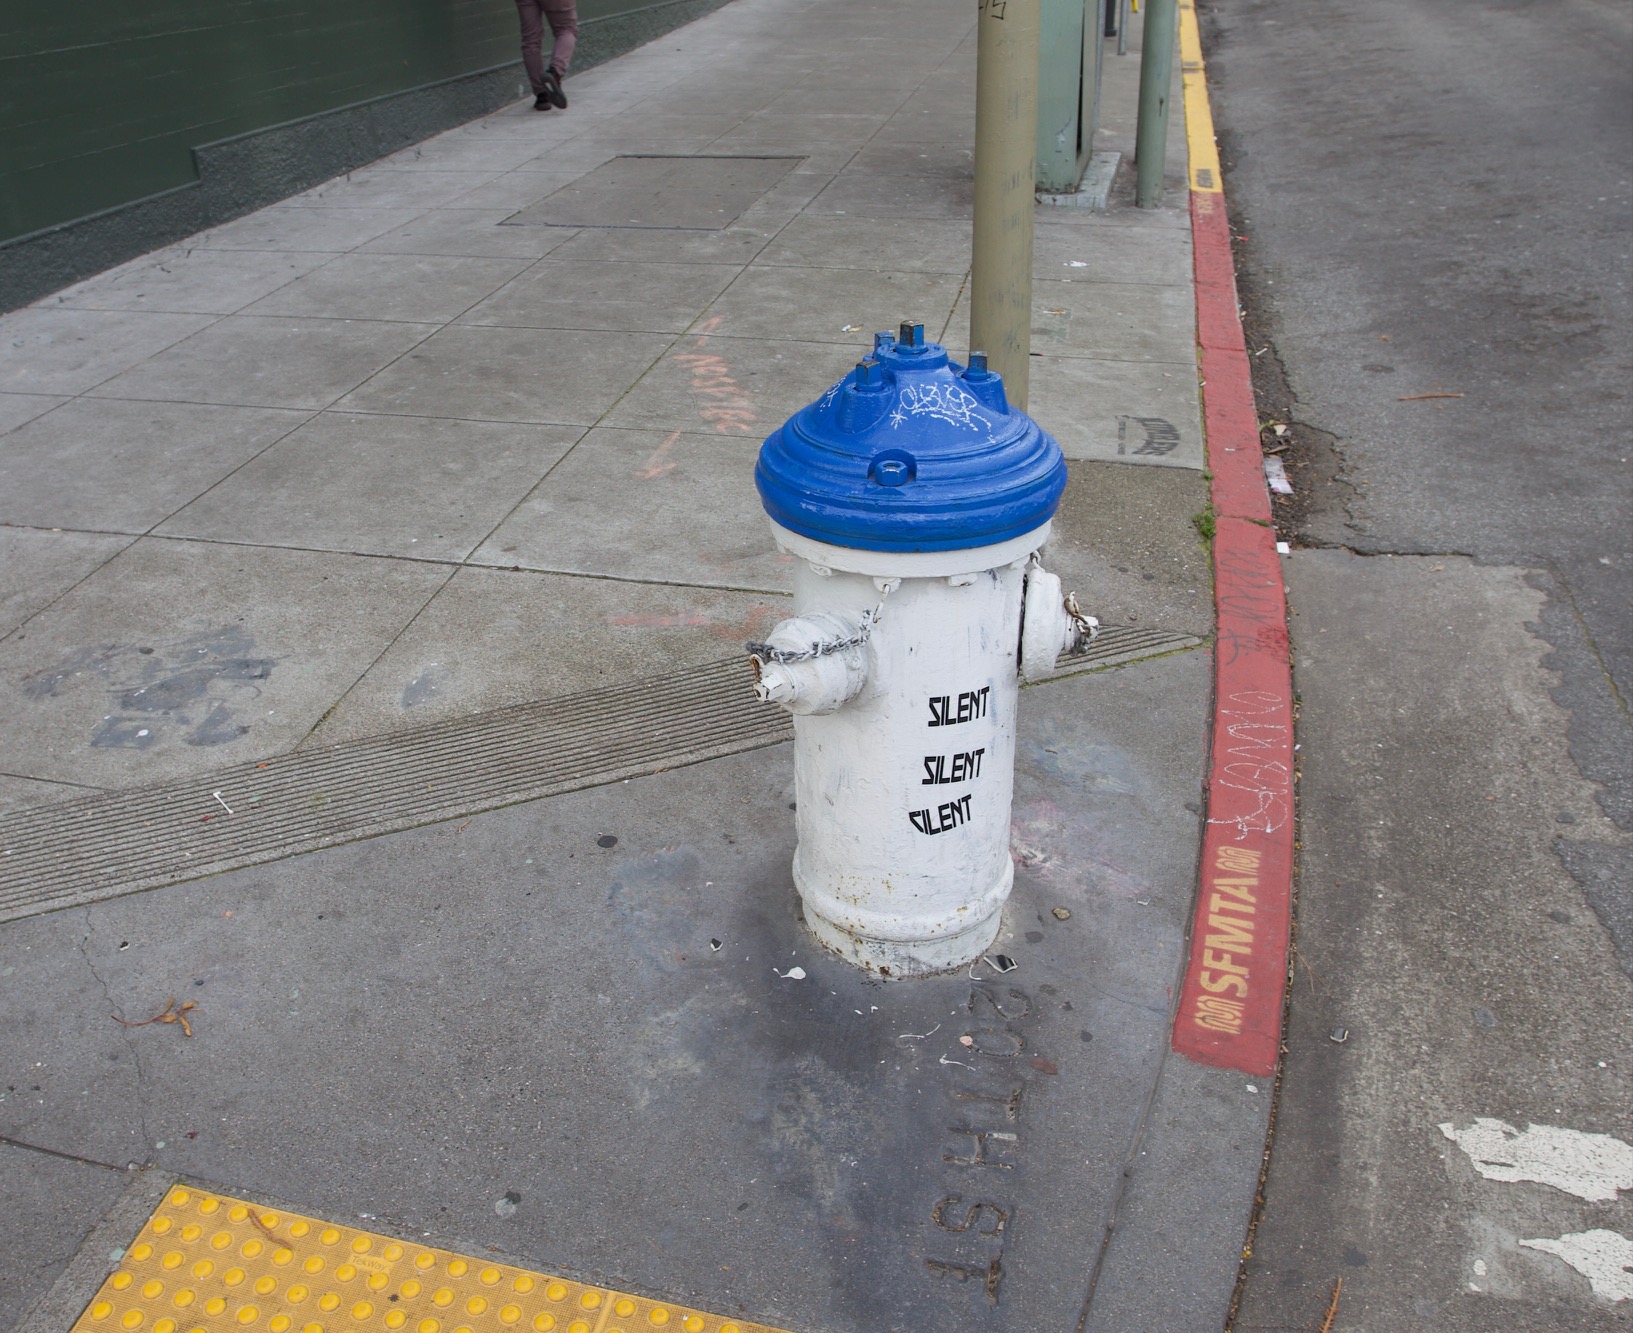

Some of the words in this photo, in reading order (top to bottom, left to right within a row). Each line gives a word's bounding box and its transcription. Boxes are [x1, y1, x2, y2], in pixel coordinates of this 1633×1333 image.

[928, 686, 990, 727] SILENT
[922, 748, 985, 785] SILENT
[1200, 877, 1259, 998] SFMTA
[924, 1196, 1008, 1307] ST
